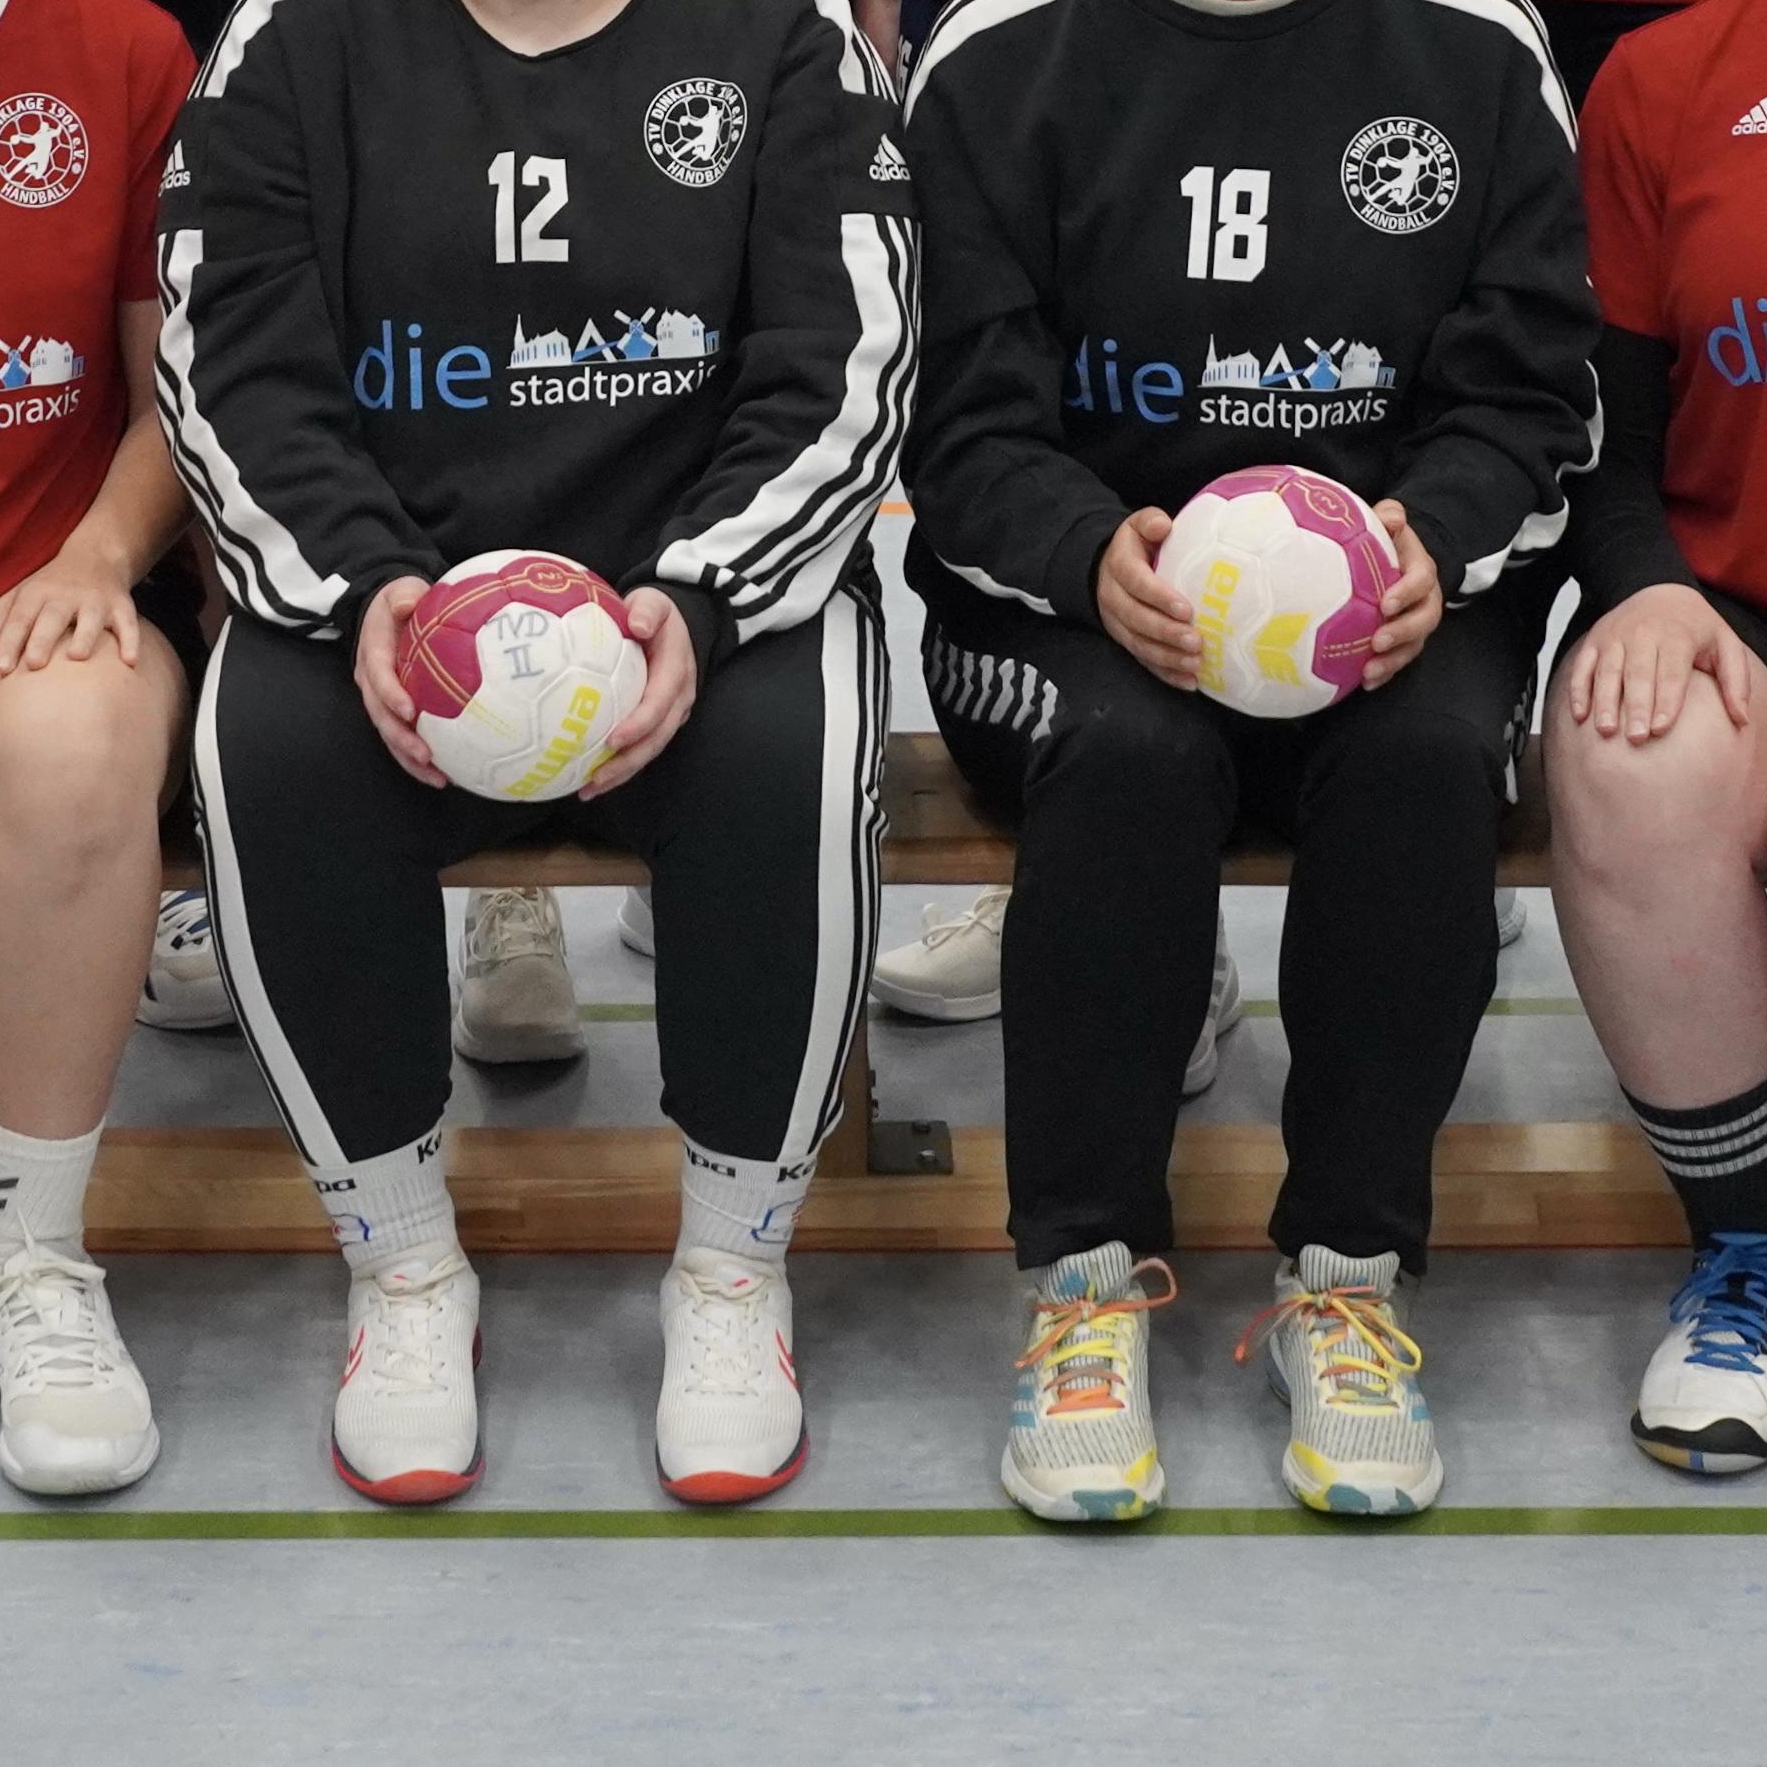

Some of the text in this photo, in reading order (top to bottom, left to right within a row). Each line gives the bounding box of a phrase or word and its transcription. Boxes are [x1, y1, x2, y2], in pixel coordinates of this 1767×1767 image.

[651, 82, 715, 120] DINKLAGE
[648, 123, 662, 141] TV
[1349, 121, 1417, 161] DINKLAGE
[1346, 163, 1358, 182] TV
[0, 182, 70, 204] HANDBALL
[488, 151, 568, 263] 12
[1181, 167, 1270, 281] 18
[1360, 204, 1431, 230] HANDBALL
[354, 318, 492, 410] die
[1199, 391, 1386, 437] stadtpraxis
[488, 611, 550, 643] TVD
